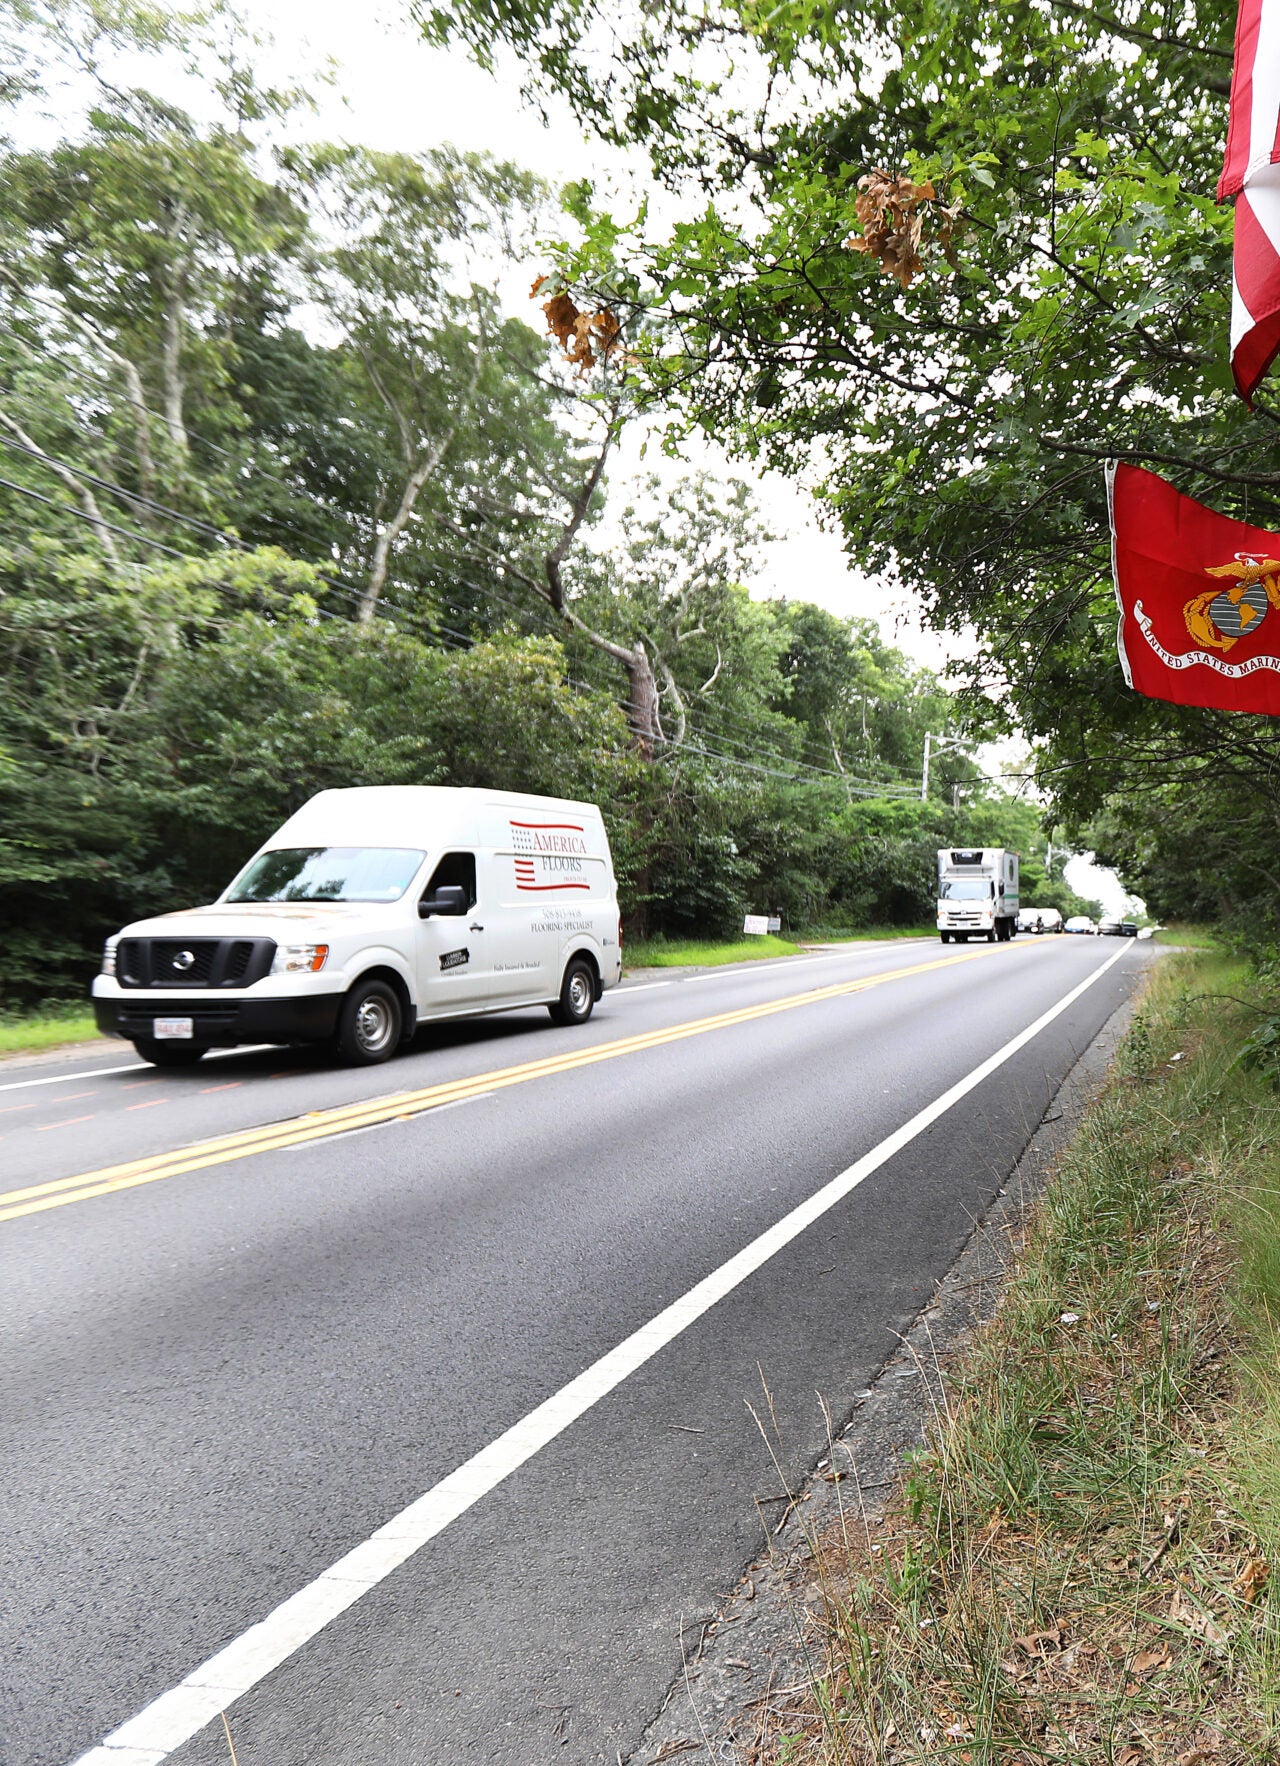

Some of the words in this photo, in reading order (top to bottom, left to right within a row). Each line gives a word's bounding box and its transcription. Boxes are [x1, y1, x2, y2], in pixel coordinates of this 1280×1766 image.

[1144, 629, 1183, 668] UNITED
[1186, 652, 1235, 676] STATES
[533, 831, 587, 854] AMERICA
[542, 855, 582, 872] FLOORS
